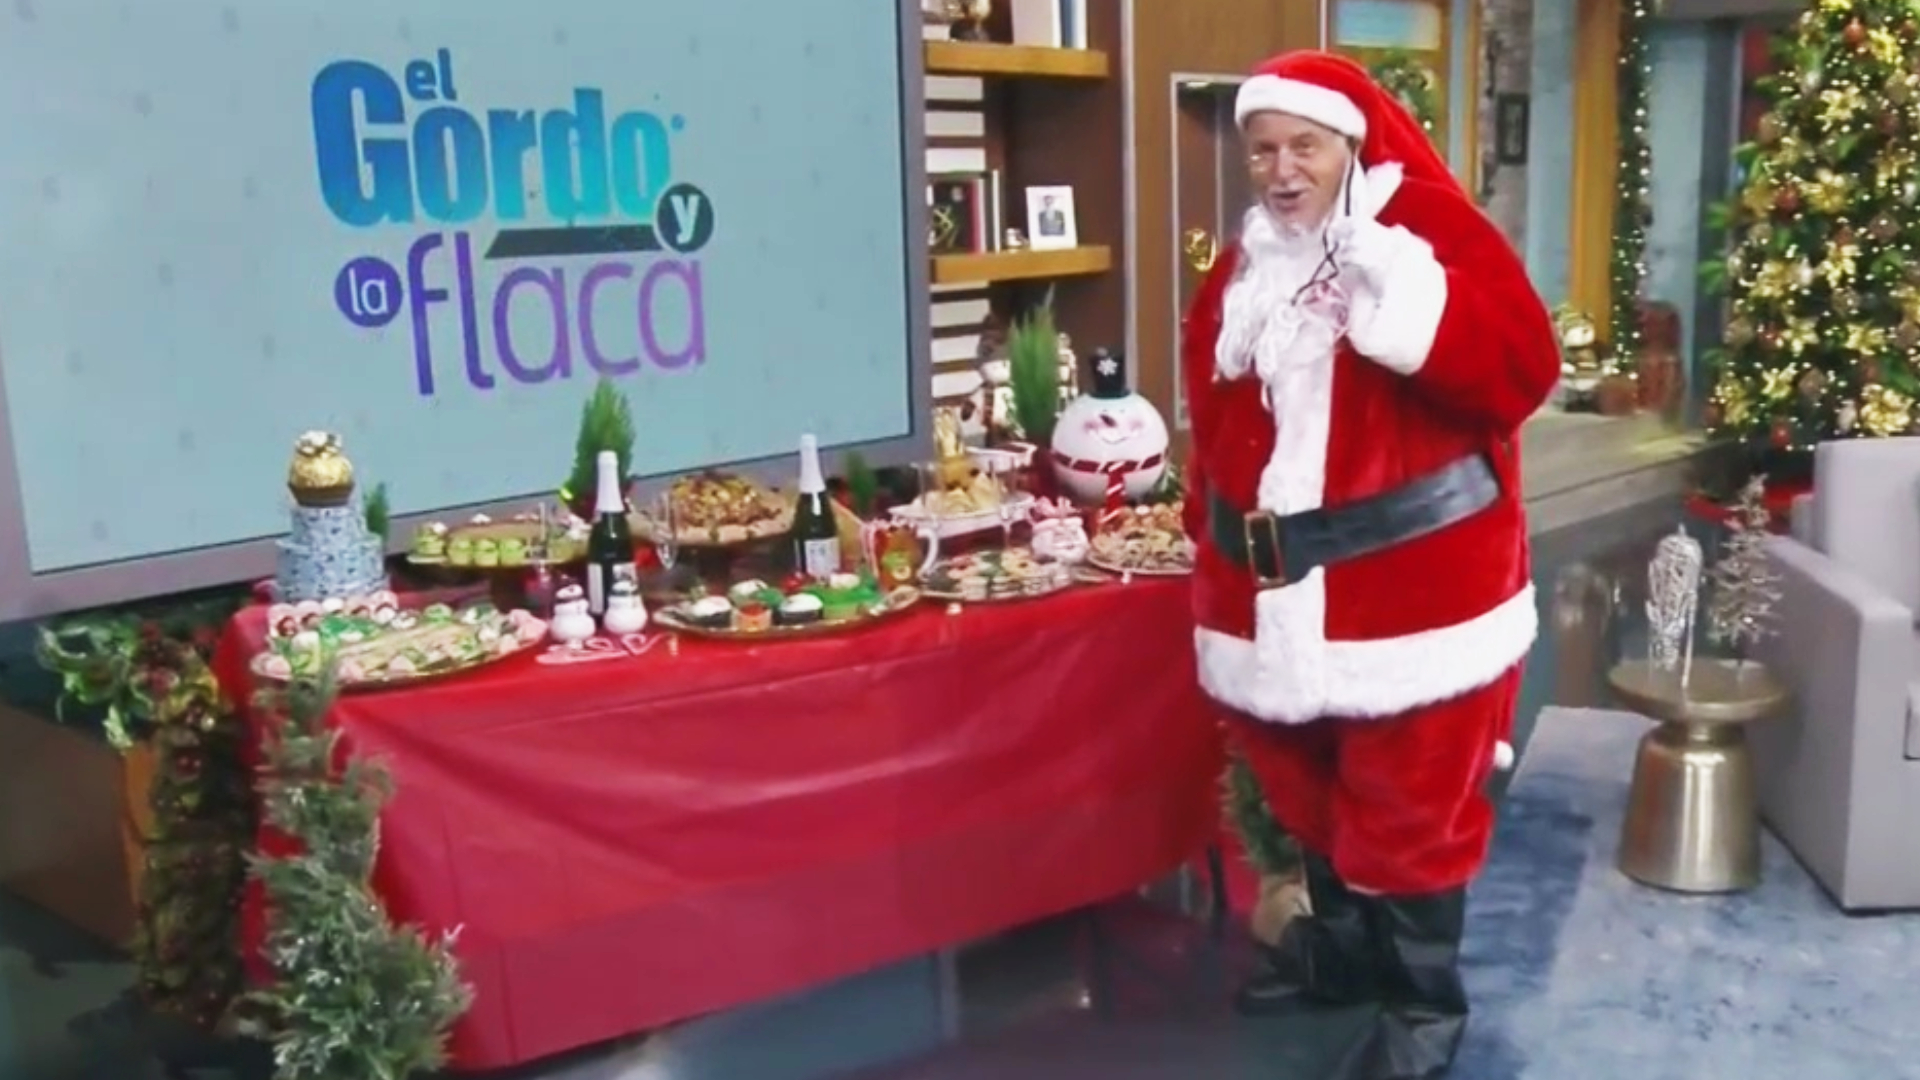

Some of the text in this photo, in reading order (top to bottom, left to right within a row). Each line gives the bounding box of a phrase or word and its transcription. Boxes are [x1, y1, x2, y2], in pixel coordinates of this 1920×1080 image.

[311, 60, 700, 244] Gordo y
[405, 48, 457, 101] el
[348, 231, 706, 396] la flaca
